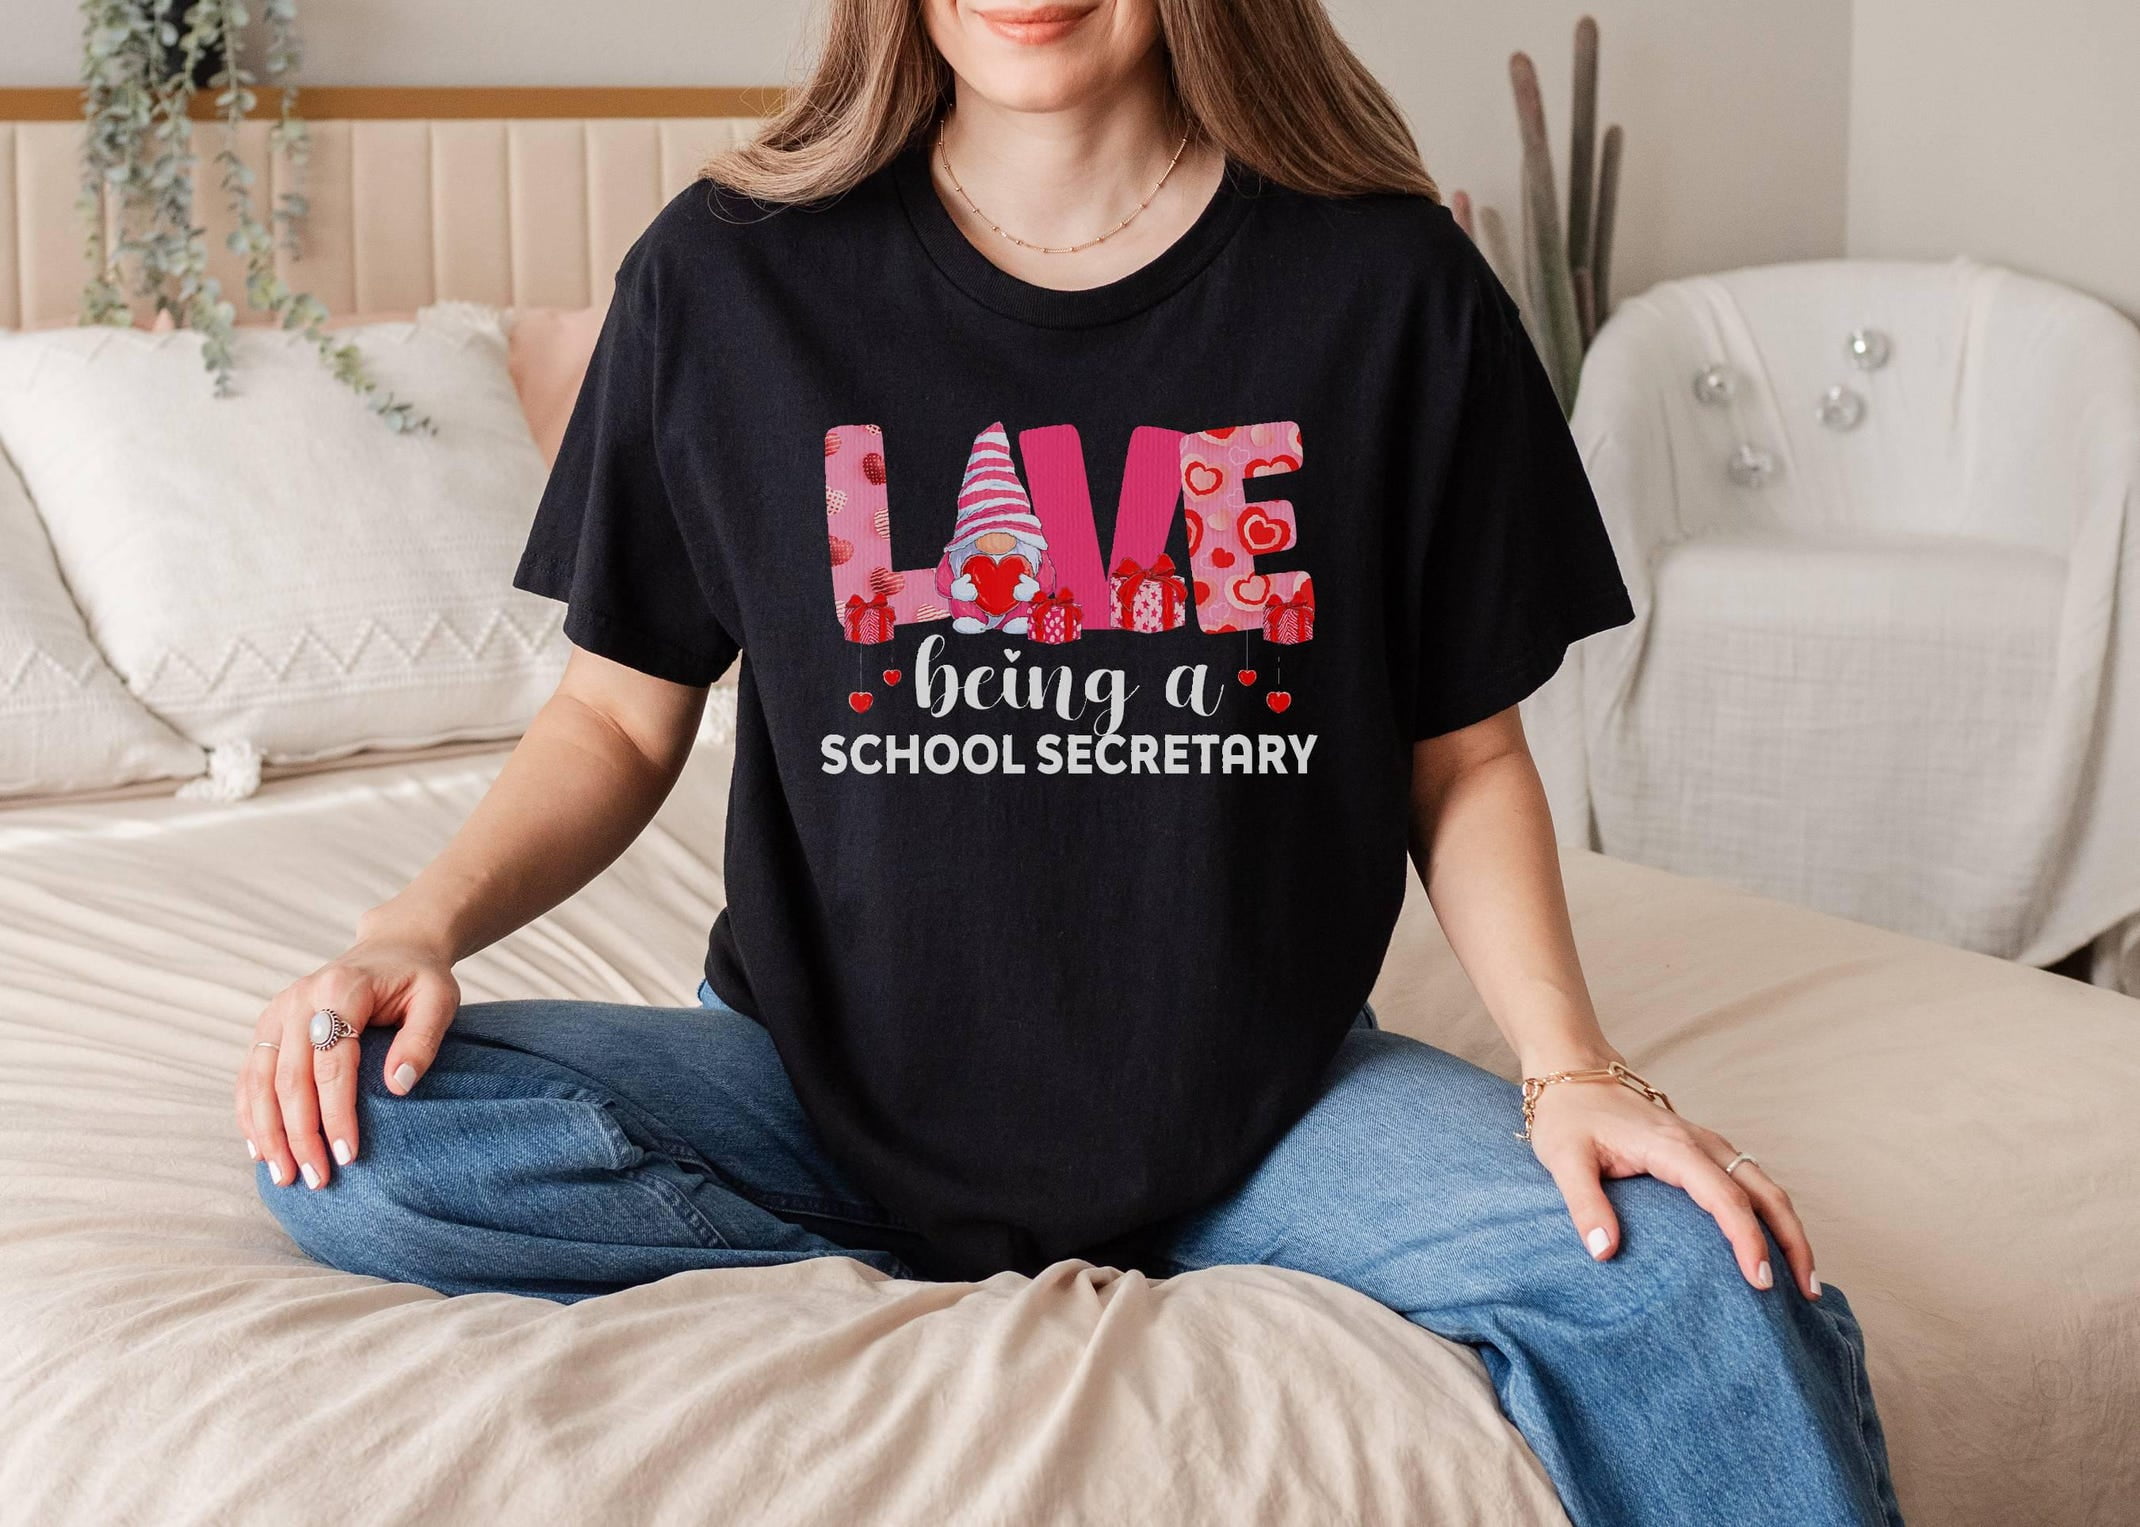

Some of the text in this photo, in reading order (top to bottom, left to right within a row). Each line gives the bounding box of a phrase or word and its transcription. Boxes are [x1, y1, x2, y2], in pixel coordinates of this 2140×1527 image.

[825, 421, 1316, 634] LVE
[914, 634, 1225, 738] being a
[820, 733, 1318, 775] SCHOOL SECRETARY
